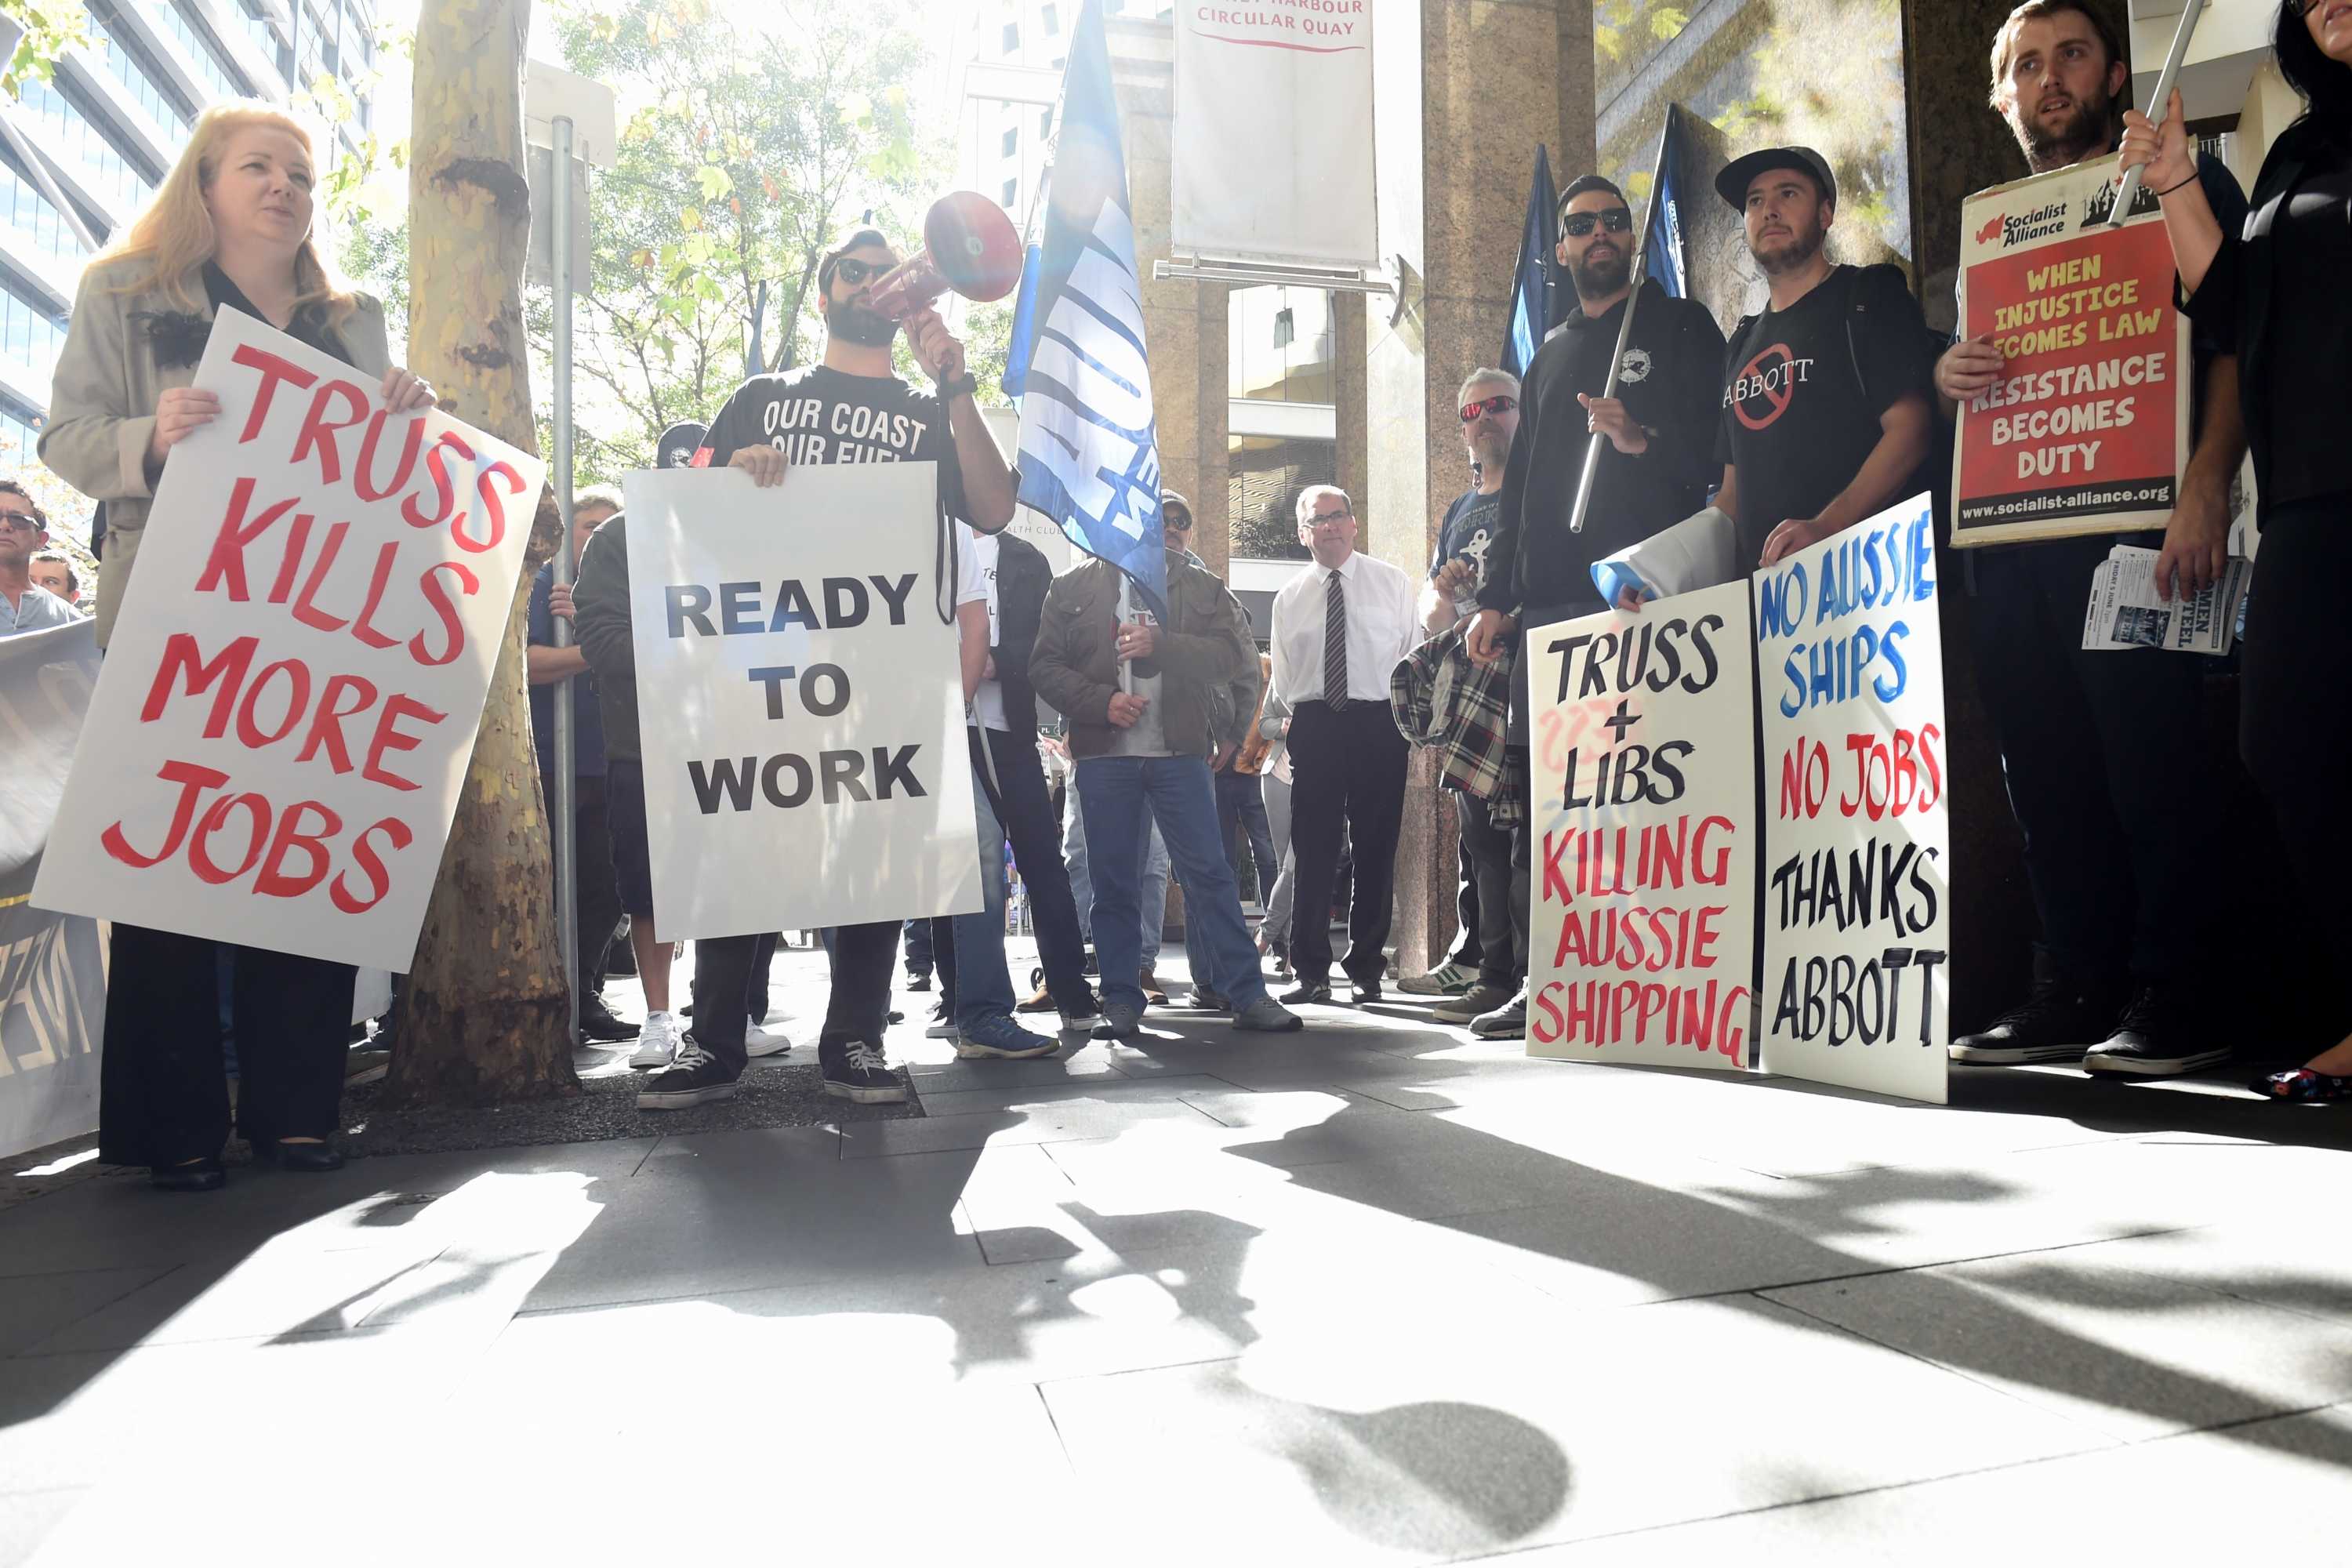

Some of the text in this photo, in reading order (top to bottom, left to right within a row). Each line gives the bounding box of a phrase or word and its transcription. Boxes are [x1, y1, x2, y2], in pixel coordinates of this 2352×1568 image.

[1197, 6, 1355, 35] CIRCULAR QUAY
[2002, 220, 2065, 248] Alliance
[2003, 202, 2067, 234] Socialist
[1994, 279, 2139, 332] INJUSTICE
[2027, 254, 2101, 293] WHEN
[2099, 308, 2162, 342] LAW
[1722, 358, 1814, 408] ABBOTT
[230, 343, 527, 554] TRUSS
[764, 398, 927, 456] OUR COAST
[1992, 397, 2135, 445] BECOMES
[2018, 441, 2102, 479] DUTY
[1962, 485, 2170, 519] www.socialist-alliance.org
[194, 477, 479, 666] KILLS
[1759, 510, 1936, 643] NO AUSSIE
[2106, 592, 2114, 608] JUNE
[2111, 561, 2121, 585] FRIDAY
[665, 573, 919, 638] READY
[2178, 597, 2196, 648] TEEL
[748, 662, 851, 720] TO
[1547, 614, 1724, 706] TRUSS
[1780, 620, 1910, 718] SHIPS
[140, 632, 449, 791] MORE
[687, 743, 928, 815] WORK
[1563, 740, 1696, 810] LIBS
[1780, 722, 1940, 822] NO JOBS
[100, 760, 413, 914] JOBS
[1543, 815, 1736, 907] KILLING
[1771, 836, 1940, 938] THANKS
[1553, 905, 1729, 973] AUSSIE
[1532, 979, 1751, 1069] SHIPPING
[1771, 947, 1947, 1047] ABBOTT
